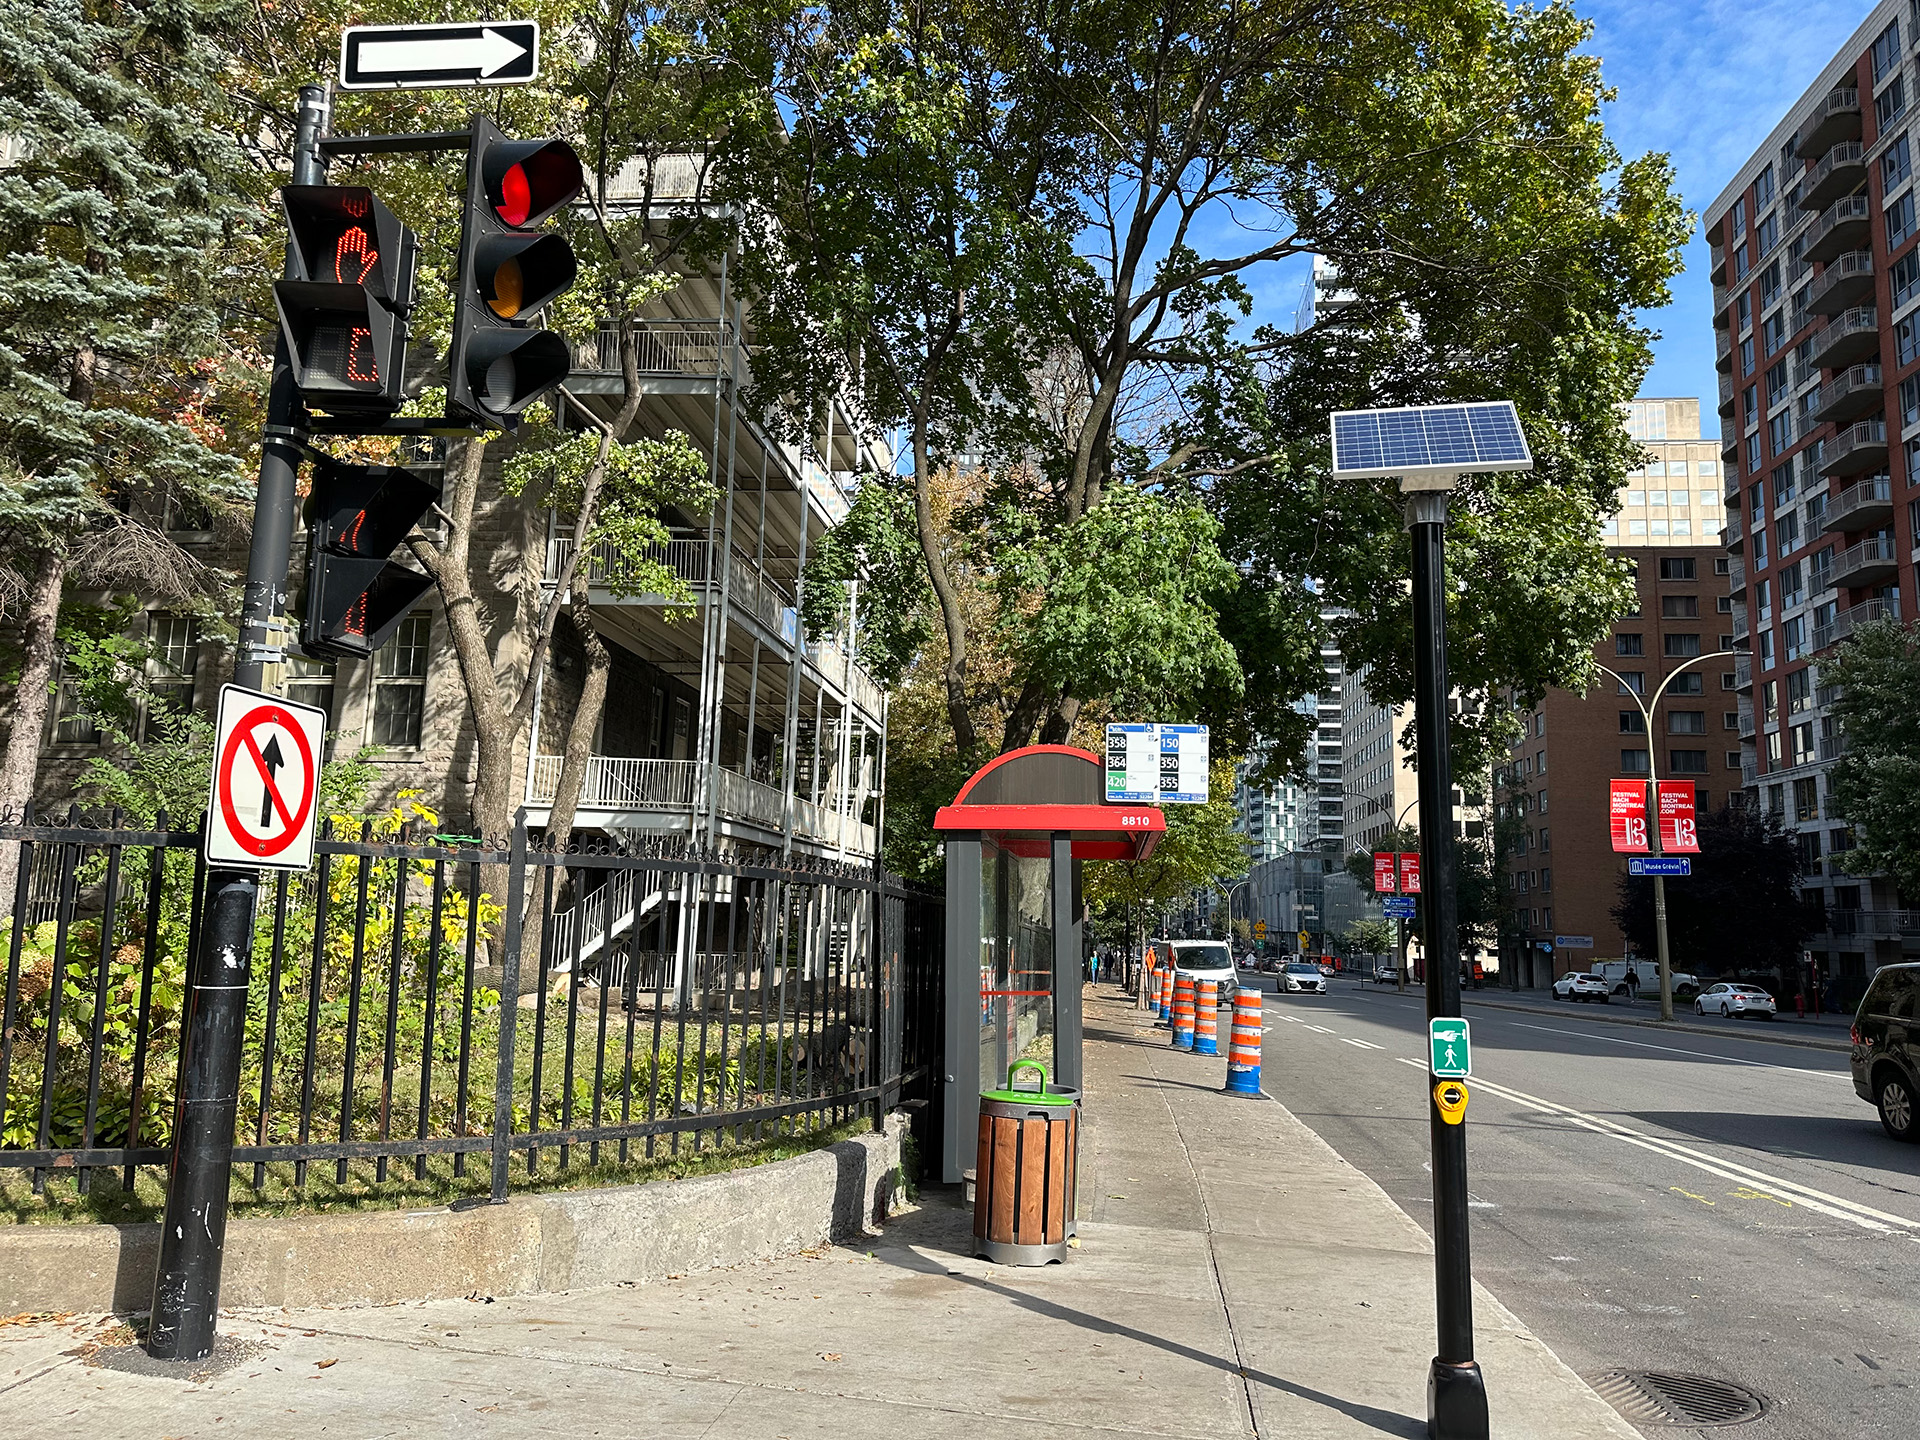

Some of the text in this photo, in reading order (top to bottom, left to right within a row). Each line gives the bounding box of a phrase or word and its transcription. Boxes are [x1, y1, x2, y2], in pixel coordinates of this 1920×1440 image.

[1108, 739, 1126, 748] 358
[1161, 738, 1179, 748] 150
[1108, 758, 1126, 768] 364
[1160, 759, 1178, 769] 350
[1108, 777, 1125, 787] 420
[1160, 778, 1178, 788] 355
[1122, 816, 1149, 826] 8810
